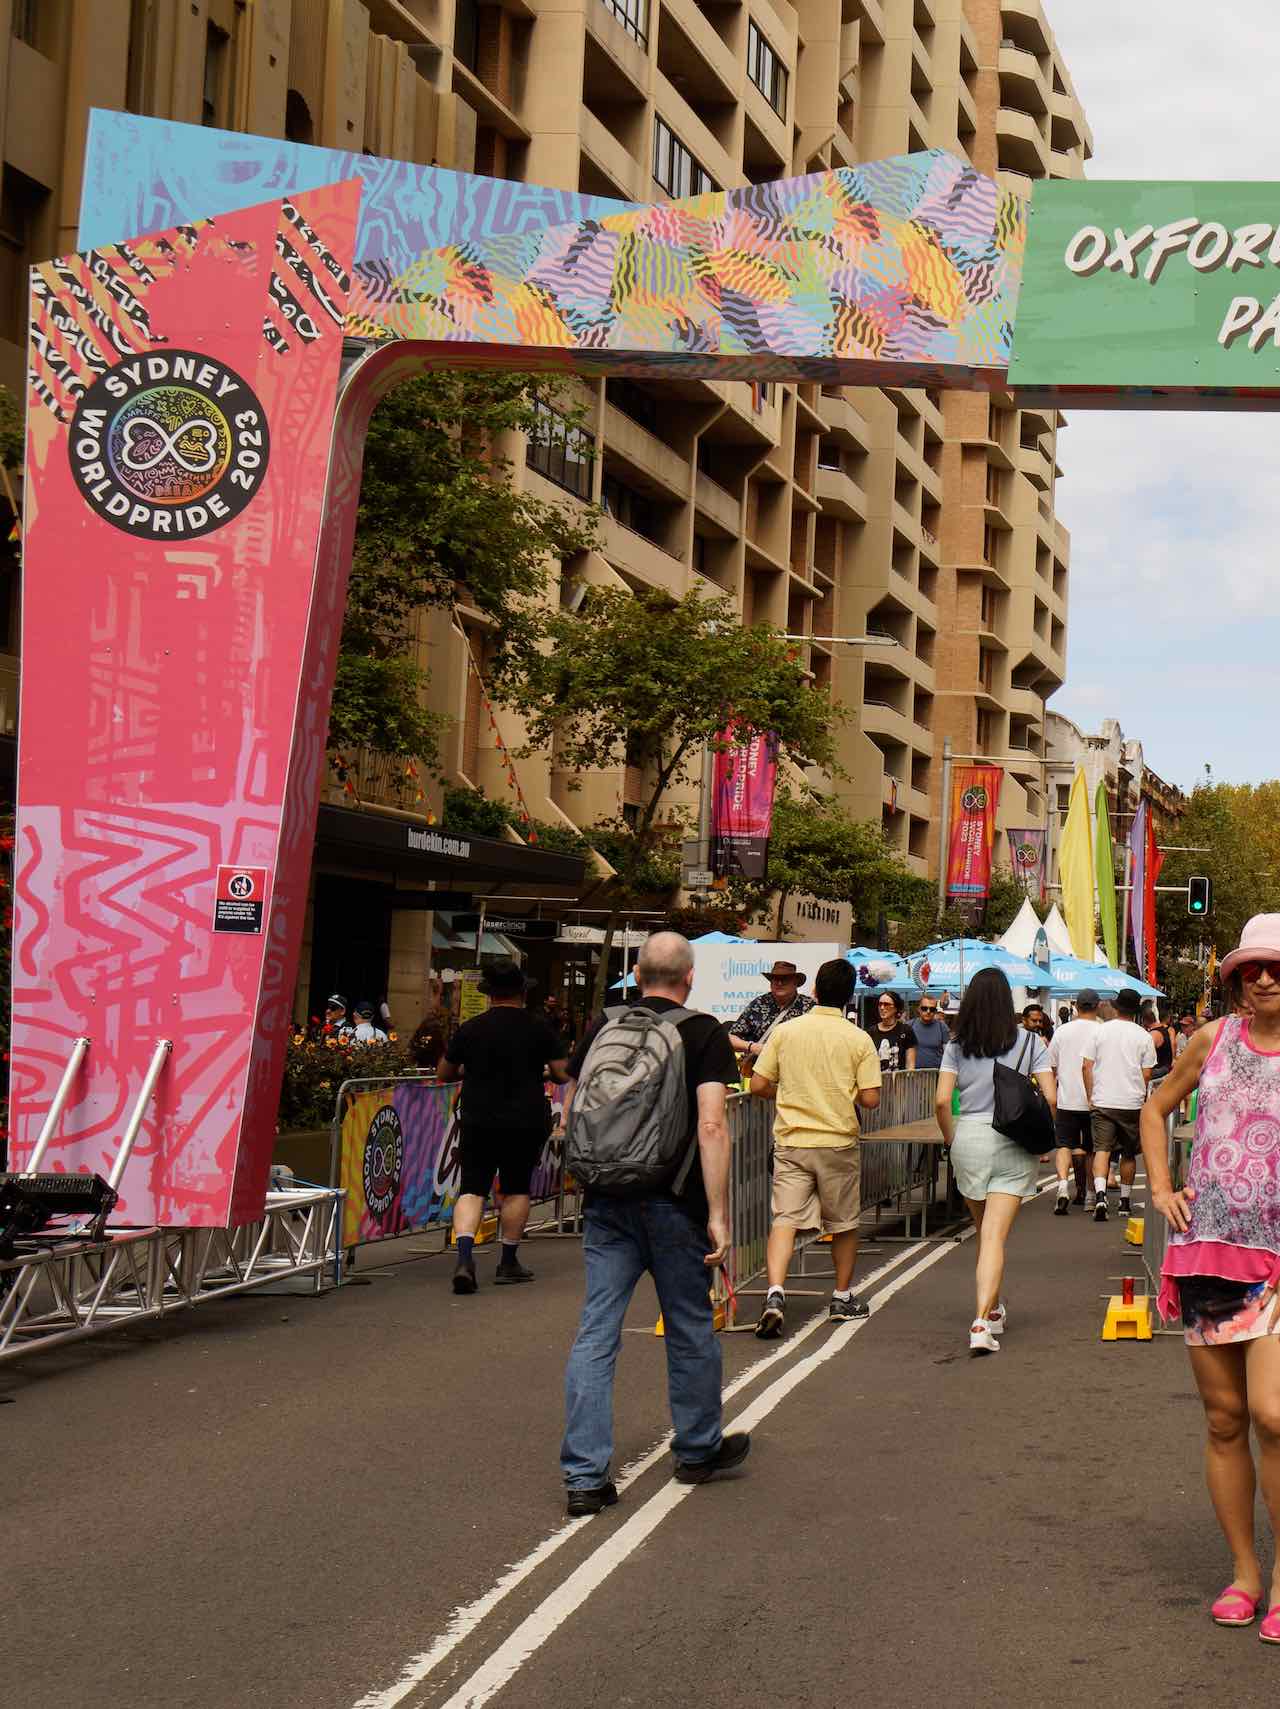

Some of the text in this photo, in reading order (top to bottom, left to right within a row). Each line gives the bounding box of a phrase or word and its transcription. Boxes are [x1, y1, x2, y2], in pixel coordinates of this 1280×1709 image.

[105, 357, 239, 398] SYDNEY
[230, 409, 262, 490] 2023
[76, 409, 231, 533] WORLDPRIDE
[408, 828, 470, 858] burdekin.com.au
[371, 1109, 399, 1136] SYDNEY
